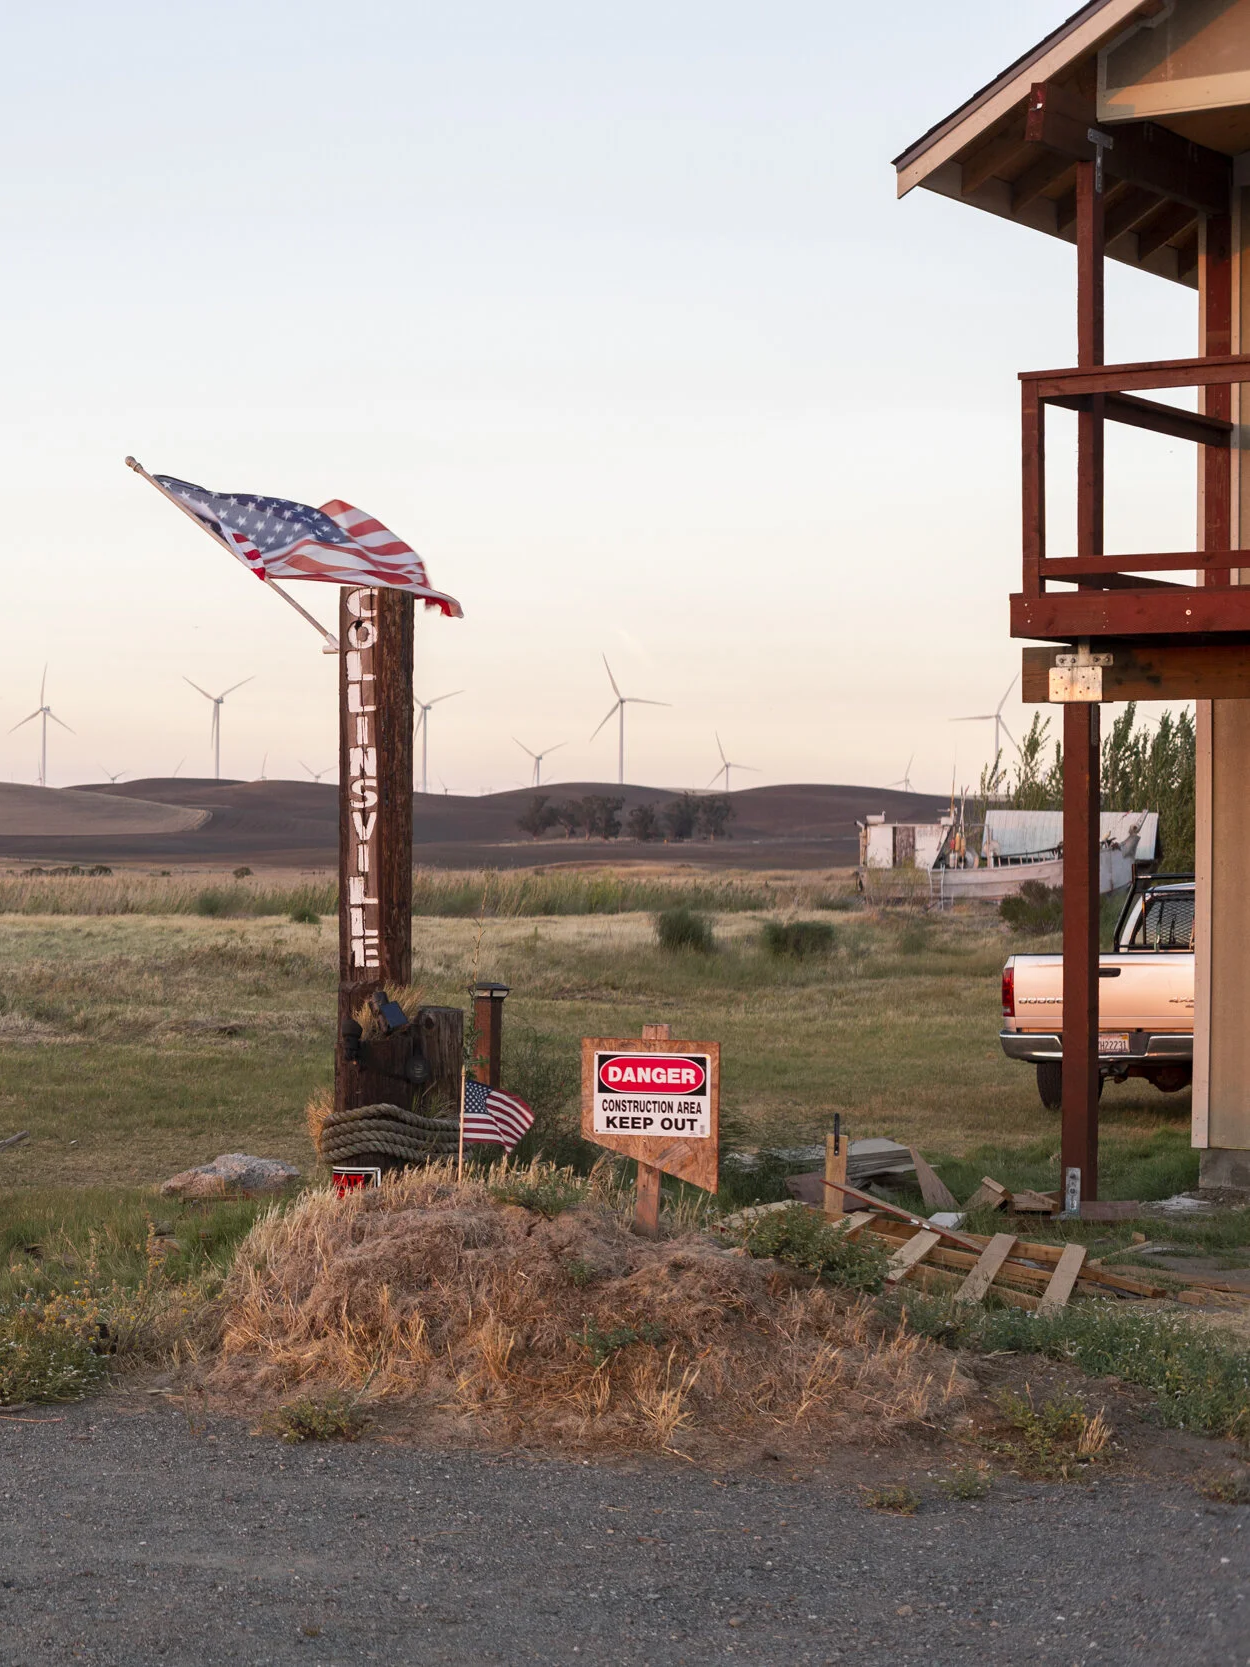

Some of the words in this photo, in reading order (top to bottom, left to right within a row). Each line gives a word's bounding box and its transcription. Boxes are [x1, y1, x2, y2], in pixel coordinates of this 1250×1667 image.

[346, 588, 380, 967] COLLINSVILLE
[1098, 1040, 1126, 1051] H22231
[608, 1066, 696, 1084] DANGER
[602, 1099, 674, 1114] CONSTRUCTION
[677, 1101, 702, 1115] AREA
[606, 1116, 654, 1130] KEEP
[660, 1118, 698, 1131] OUT
